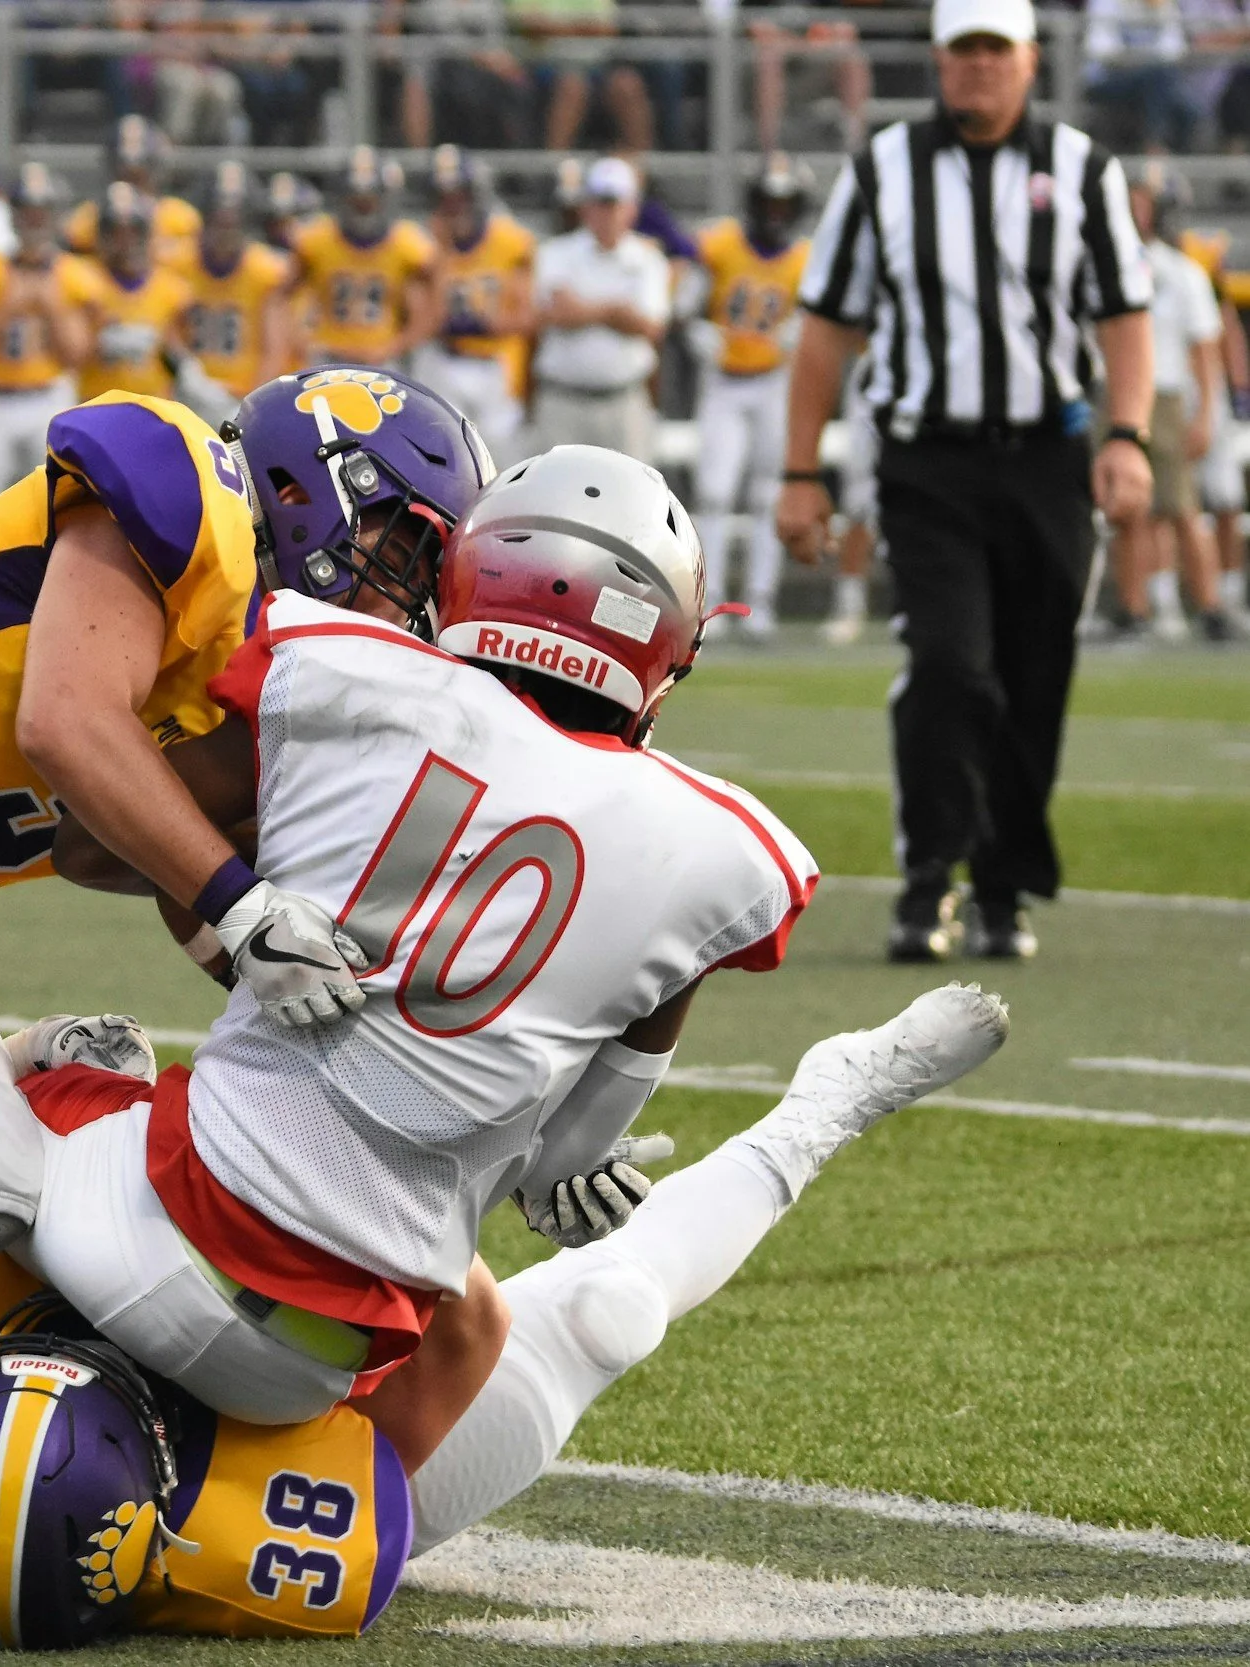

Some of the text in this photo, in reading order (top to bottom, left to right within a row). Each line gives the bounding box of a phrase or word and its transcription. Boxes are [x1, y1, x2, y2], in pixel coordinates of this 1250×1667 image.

[476, 627, 610, 689] Riddell
[335, 748, 585, 1038] 10
[9, 1359, 79, 1380] Riddell
[246, 1468, 359, 1611] 38
